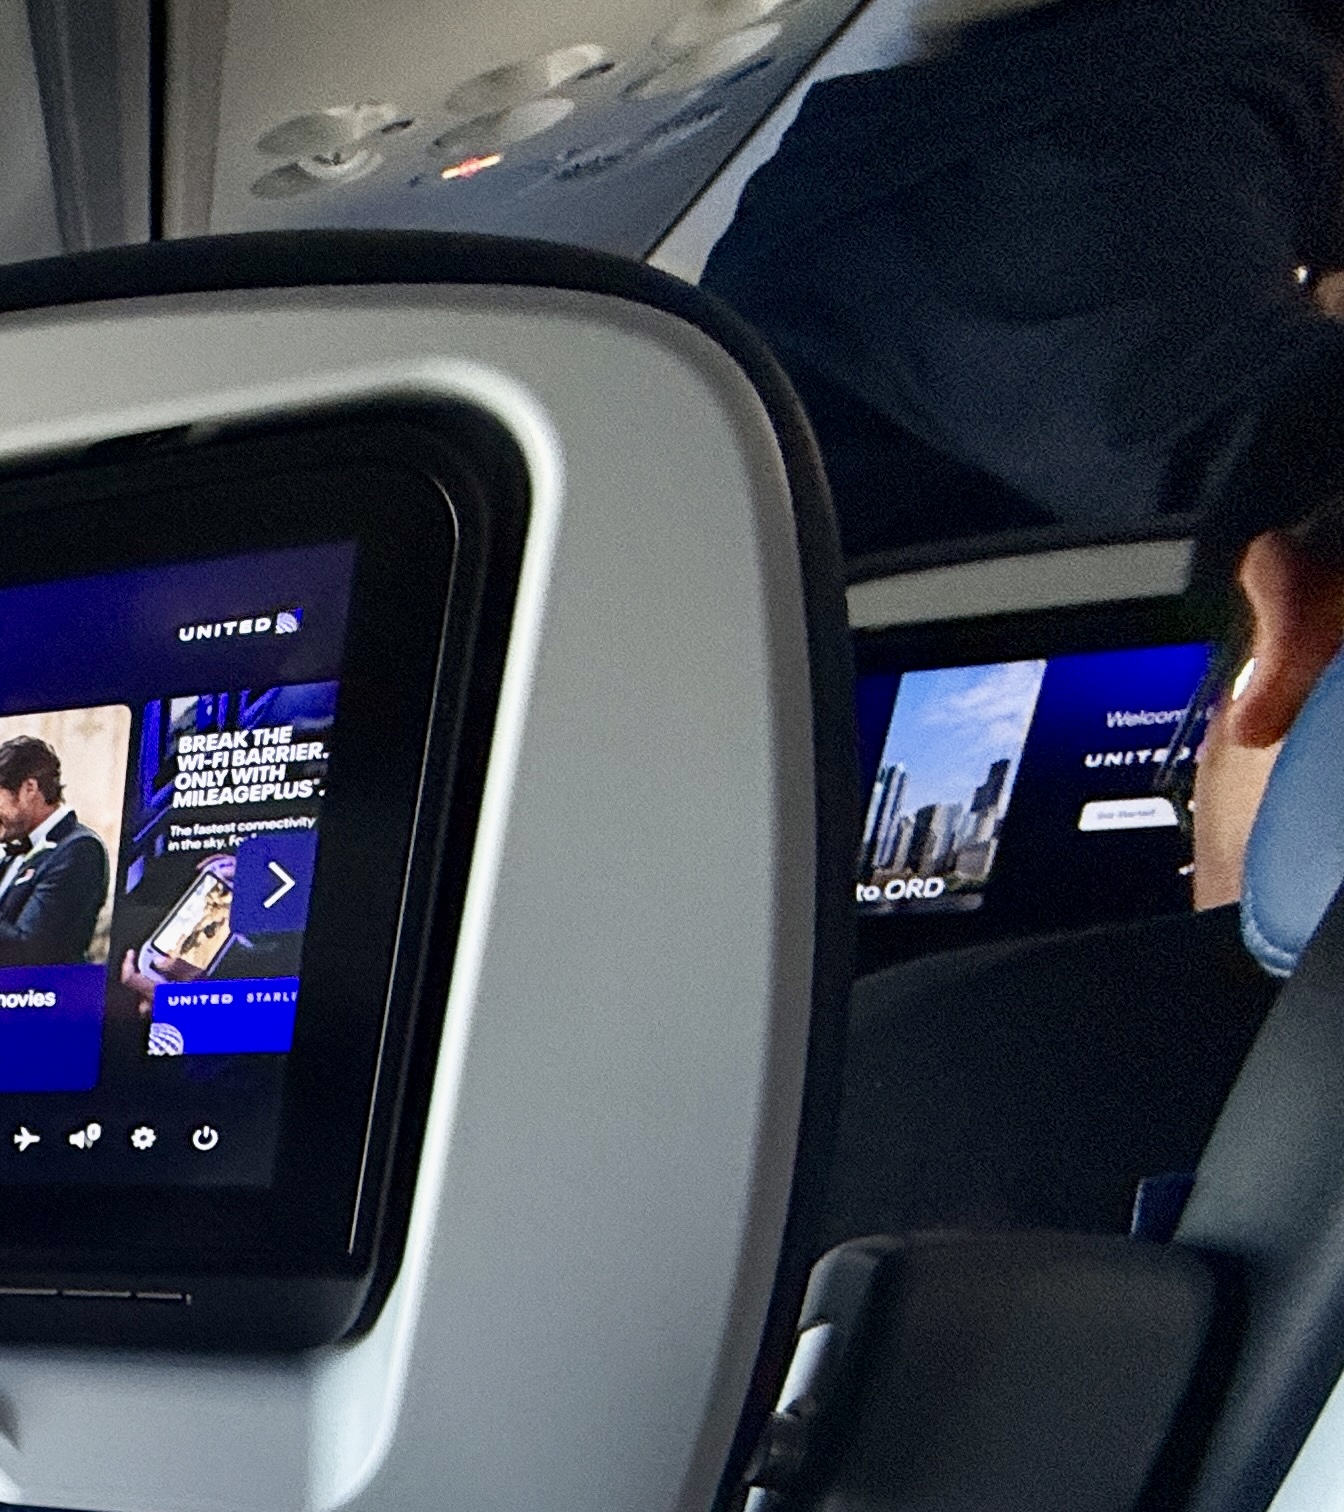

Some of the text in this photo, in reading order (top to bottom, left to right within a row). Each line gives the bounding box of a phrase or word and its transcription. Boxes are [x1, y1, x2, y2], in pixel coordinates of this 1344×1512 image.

[178, 616, 272, 642] UNITED
[1106, 708, 1198, 728] Welcom
[178, 725, 293, 754] BREAK THE
[177, 741, 330, 772] WI-FI BARRIER.
[174, 764, 287, 791] ONLY WITH
[170, 816, 318, 837] The fastest connectivity
[168, 839, 181, 851] in
[181, 837, 202, 850] the
[202, 836, 226, 850] sky.
[884, 877, 946, 900] ORD
[168, 993, 234, 1006] UNITED
